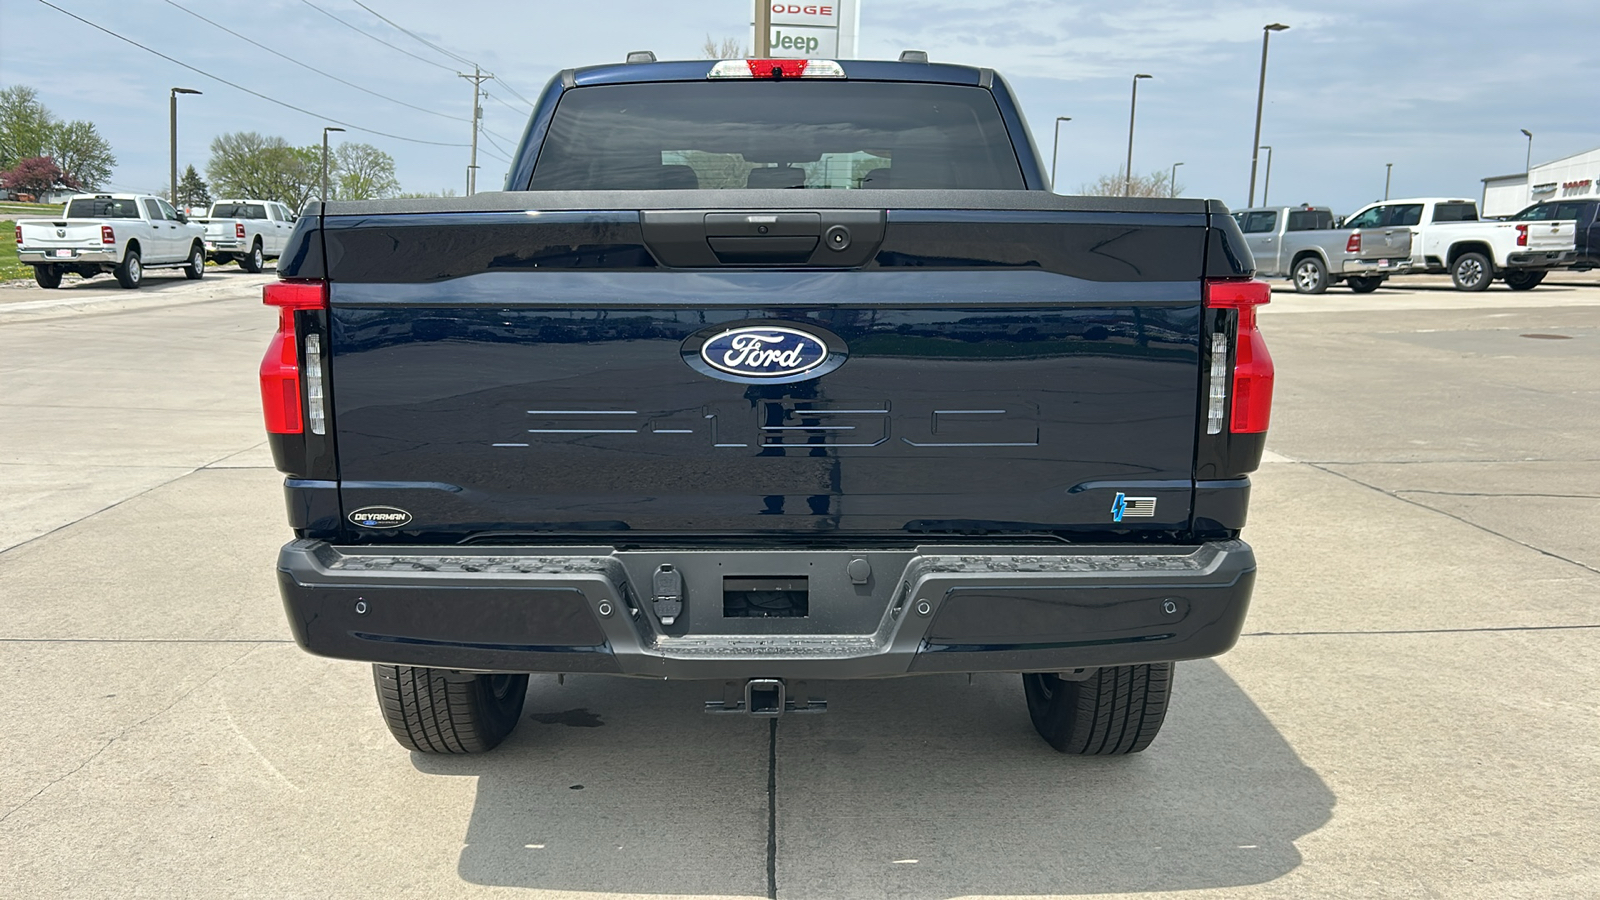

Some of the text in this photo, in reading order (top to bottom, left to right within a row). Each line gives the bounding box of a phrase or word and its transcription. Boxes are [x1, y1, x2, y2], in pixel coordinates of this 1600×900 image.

[771, 4, 833, 16] ODGE
[770, 30, 819, 54] Jeep
[723, 333, 805, 368] Ford
[491, 399, 1040, 447] F-150
[354, 513, 406, 521] DEYARMAN
